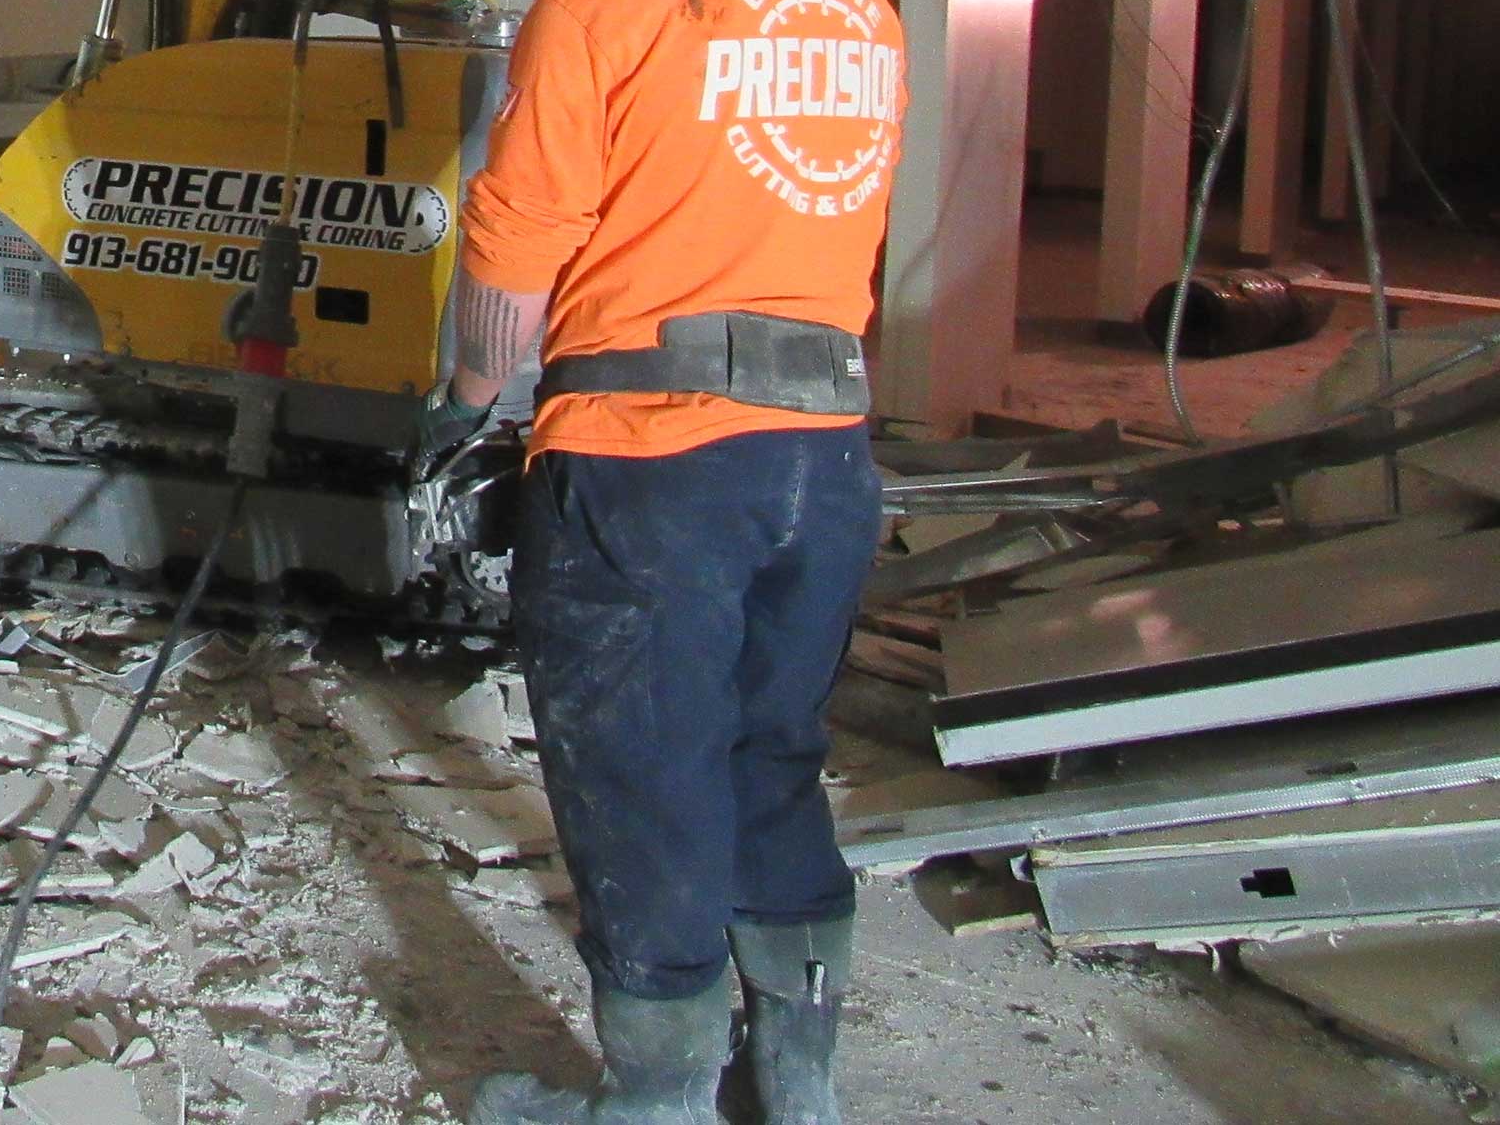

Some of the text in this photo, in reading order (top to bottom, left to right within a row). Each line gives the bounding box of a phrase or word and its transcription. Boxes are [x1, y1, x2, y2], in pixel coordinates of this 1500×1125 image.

[93, 161, 415, 228] PRECISION
[815, 195, 838, 216] &
[86, 203, 194, 230] CONCRETE
[195, 212, 275, 238] CUTTIN
[317, 225, 406, 251] CORING
[65, 233, 318, 288] 913-681-900
